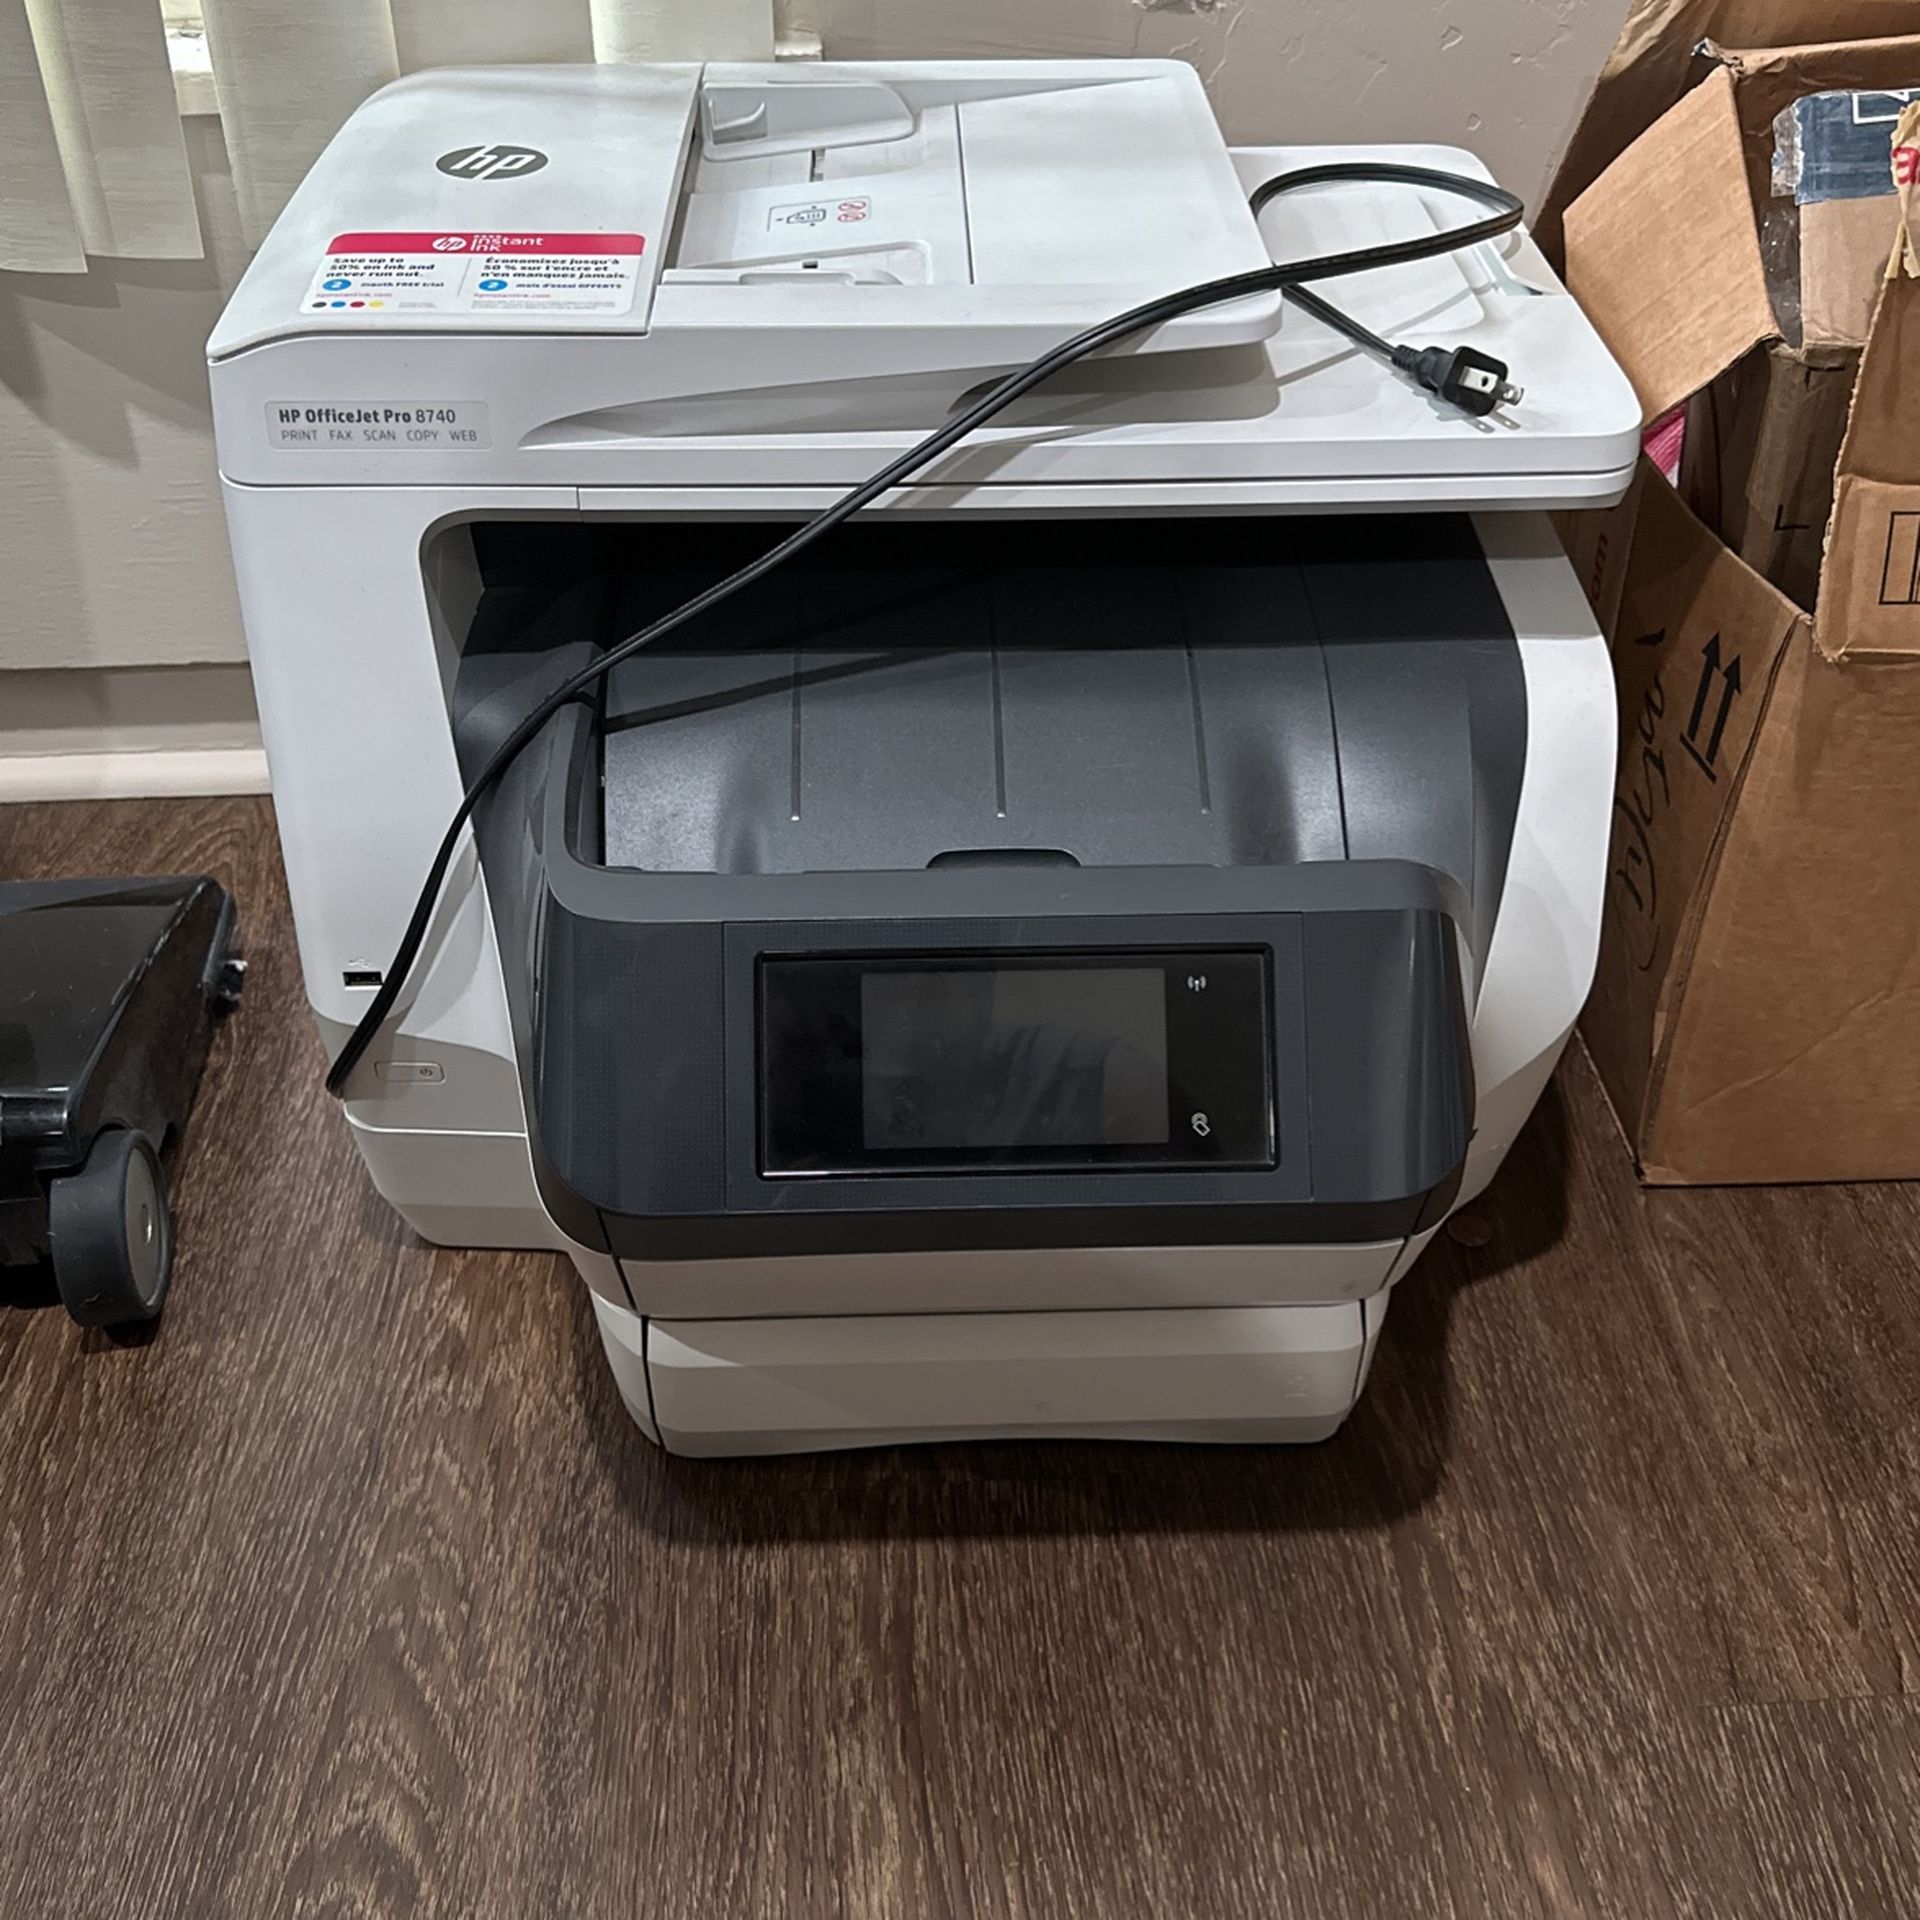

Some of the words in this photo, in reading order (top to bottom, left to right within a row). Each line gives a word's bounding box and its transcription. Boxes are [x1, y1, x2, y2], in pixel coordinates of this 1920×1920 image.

[445, 144, 540, 180] hp
[434, 237, 465, 251] hp
[471, 234, 544, 246] instant
[279, 409, 301, 423] HP
[305, 409, 380, 423] OfficeJet
[384, 409, 412, 423] Pro
[415, 409, 456, 424] 8740
[281, 429, 318, 441] PRINT
[329, 429, 353, 441] FAX
[363, 429, 396, 441] SCAN
[406, 429, 439, 441] COPY
[449, 429, 478, 441] WEB
